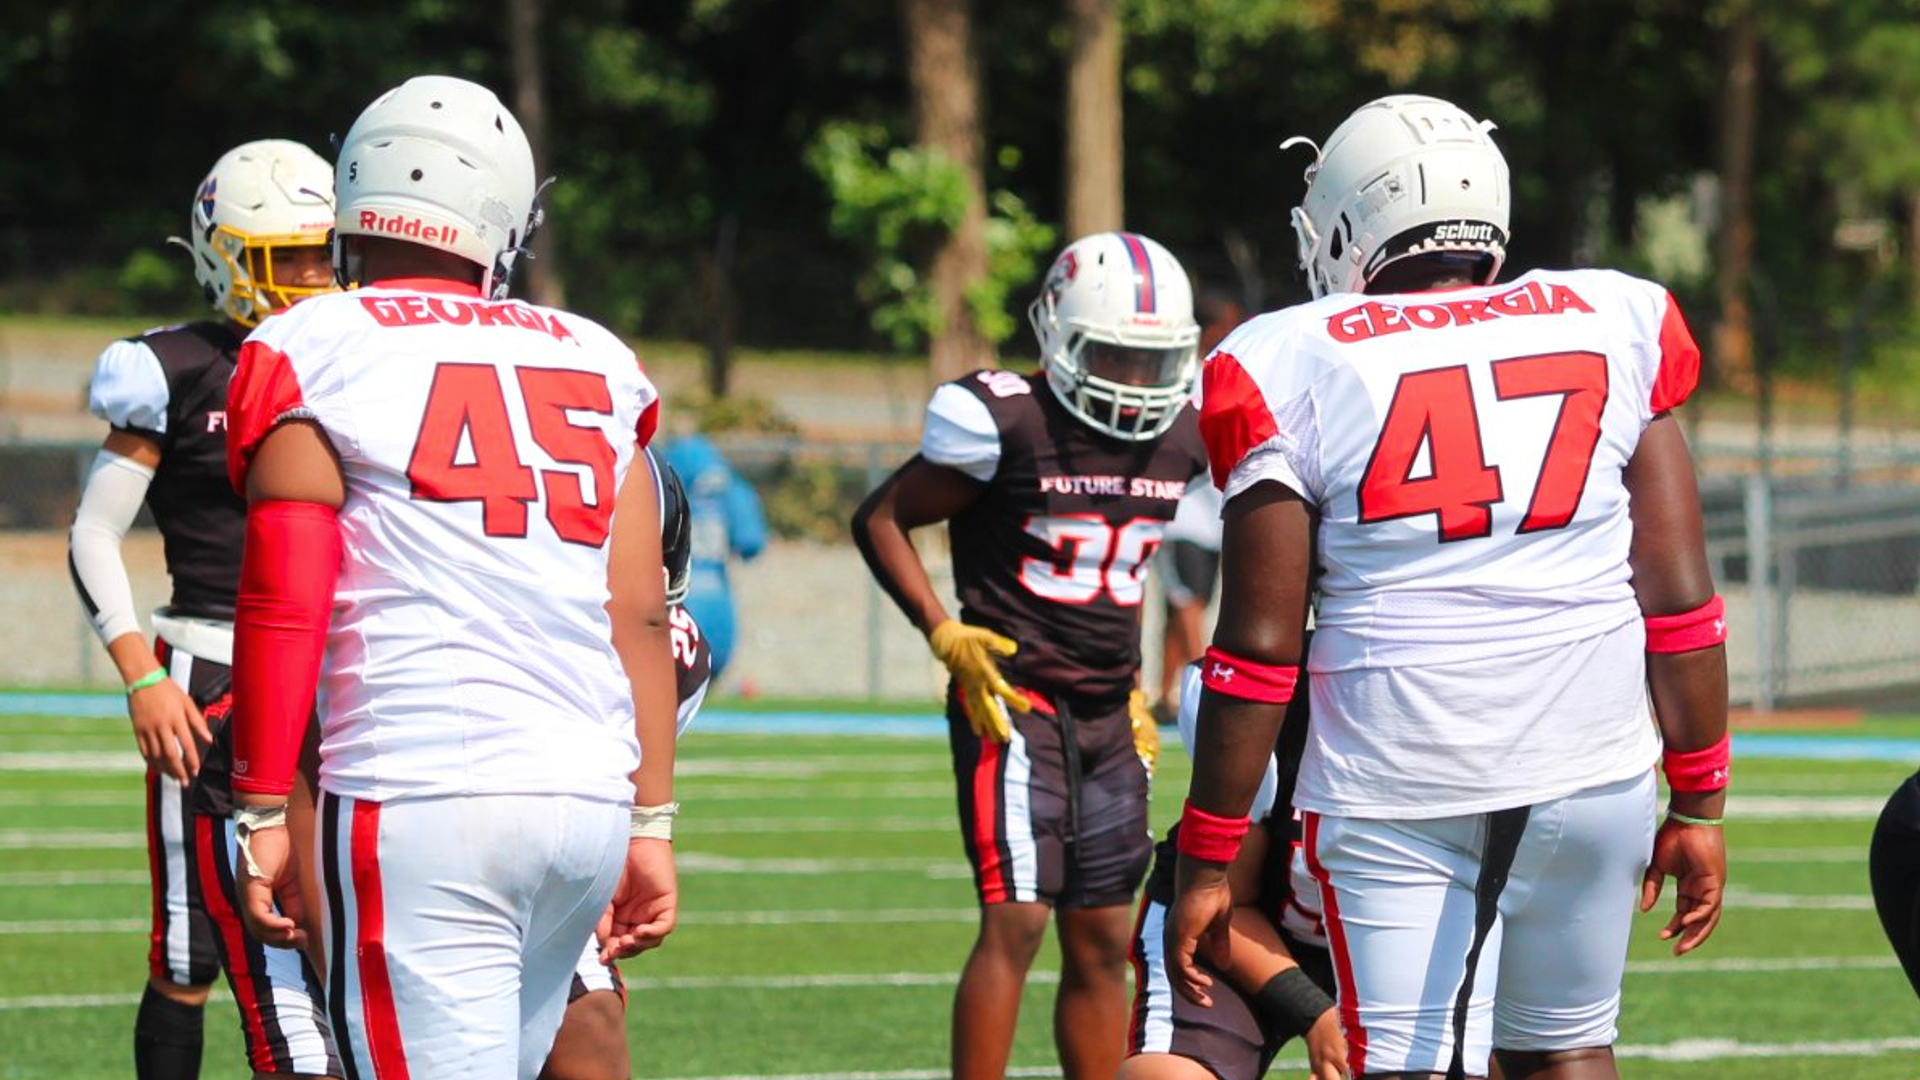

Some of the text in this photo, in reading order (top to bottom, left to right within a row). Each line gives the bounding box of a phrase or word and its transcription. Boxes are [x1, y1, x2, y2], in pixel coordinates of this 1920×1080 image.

[360, 211, 459, 246] Riddell
[1434, 220, 1494, 242] schutt
[1326, 280, 1597, 343] GEORGIA
[405, 362, 617, 550] 45
[1356, 350, 1609, 543] 47
[1039, 476, 1125, 496] FUTURE
